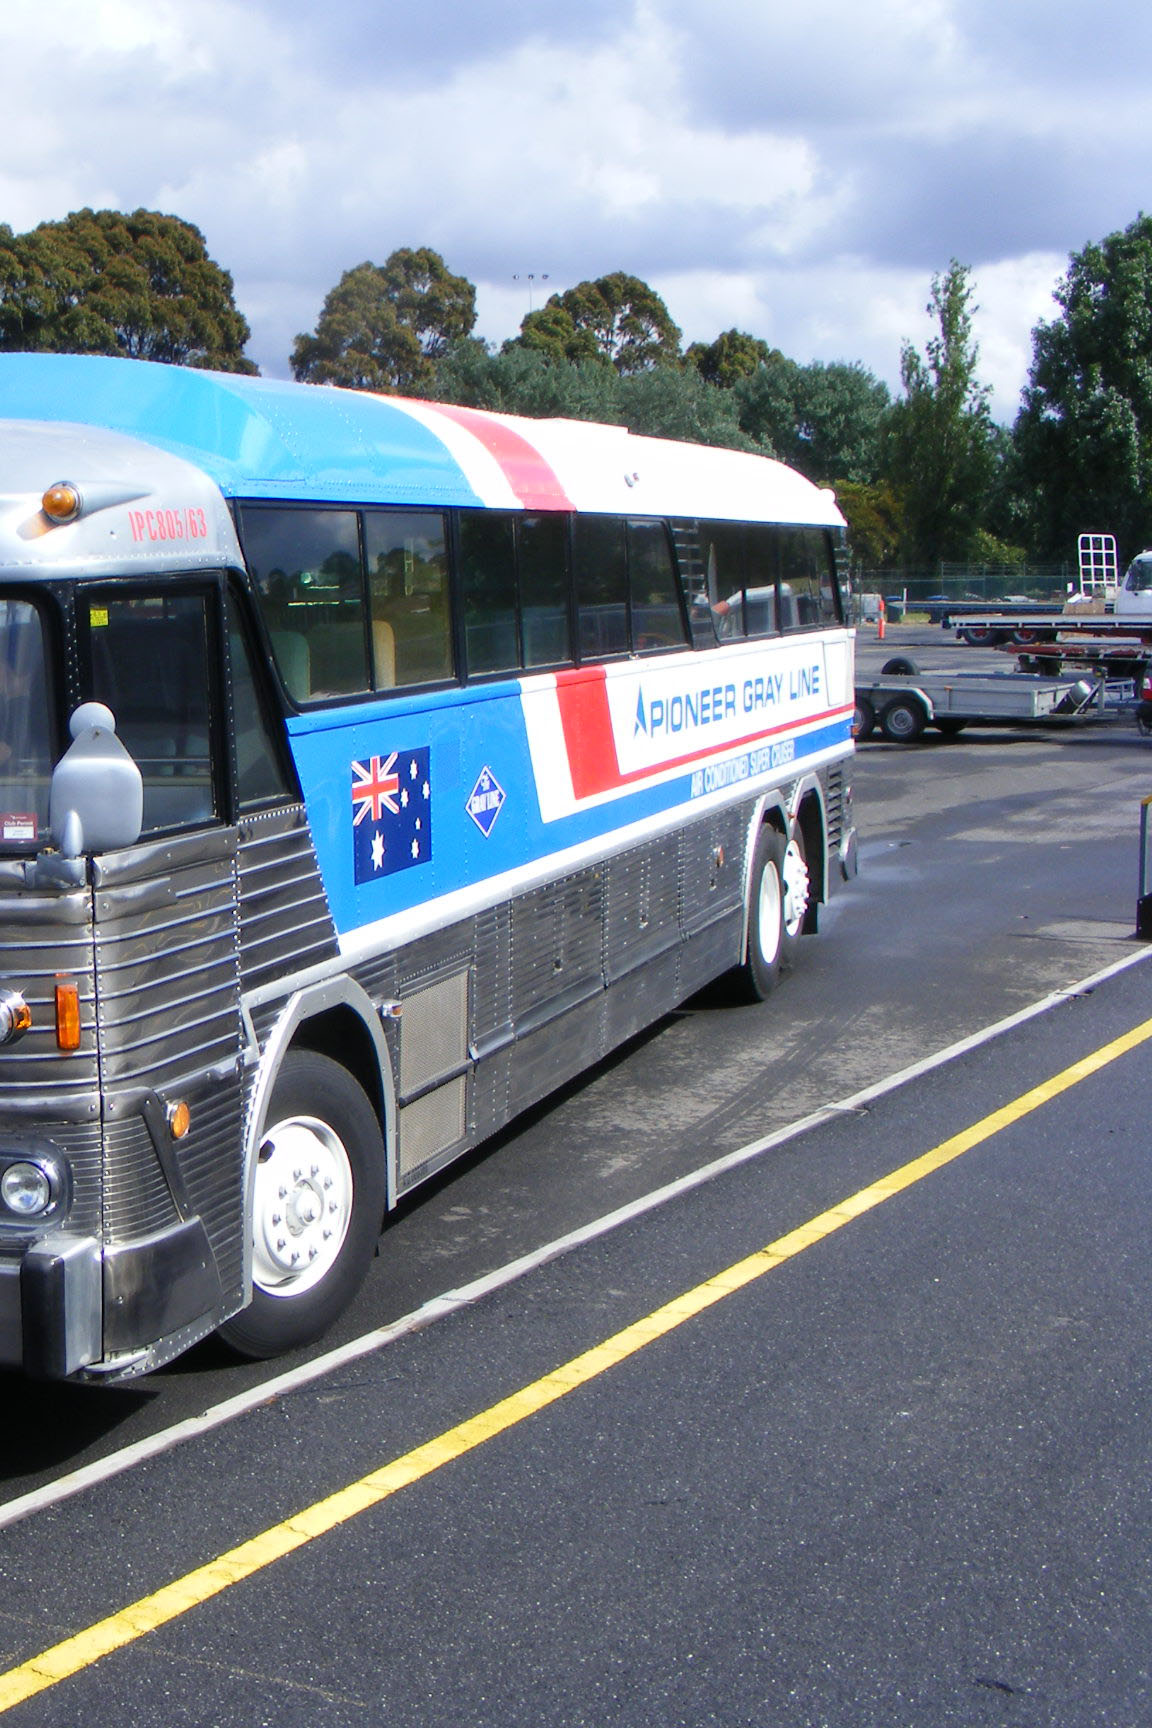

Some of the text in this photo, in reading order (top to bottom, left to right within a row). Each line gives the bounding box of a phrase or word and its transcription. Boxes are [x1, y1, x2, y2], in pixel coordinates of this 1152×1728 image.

[650, 665, 820, 738] PIONEER GRAY LINE
